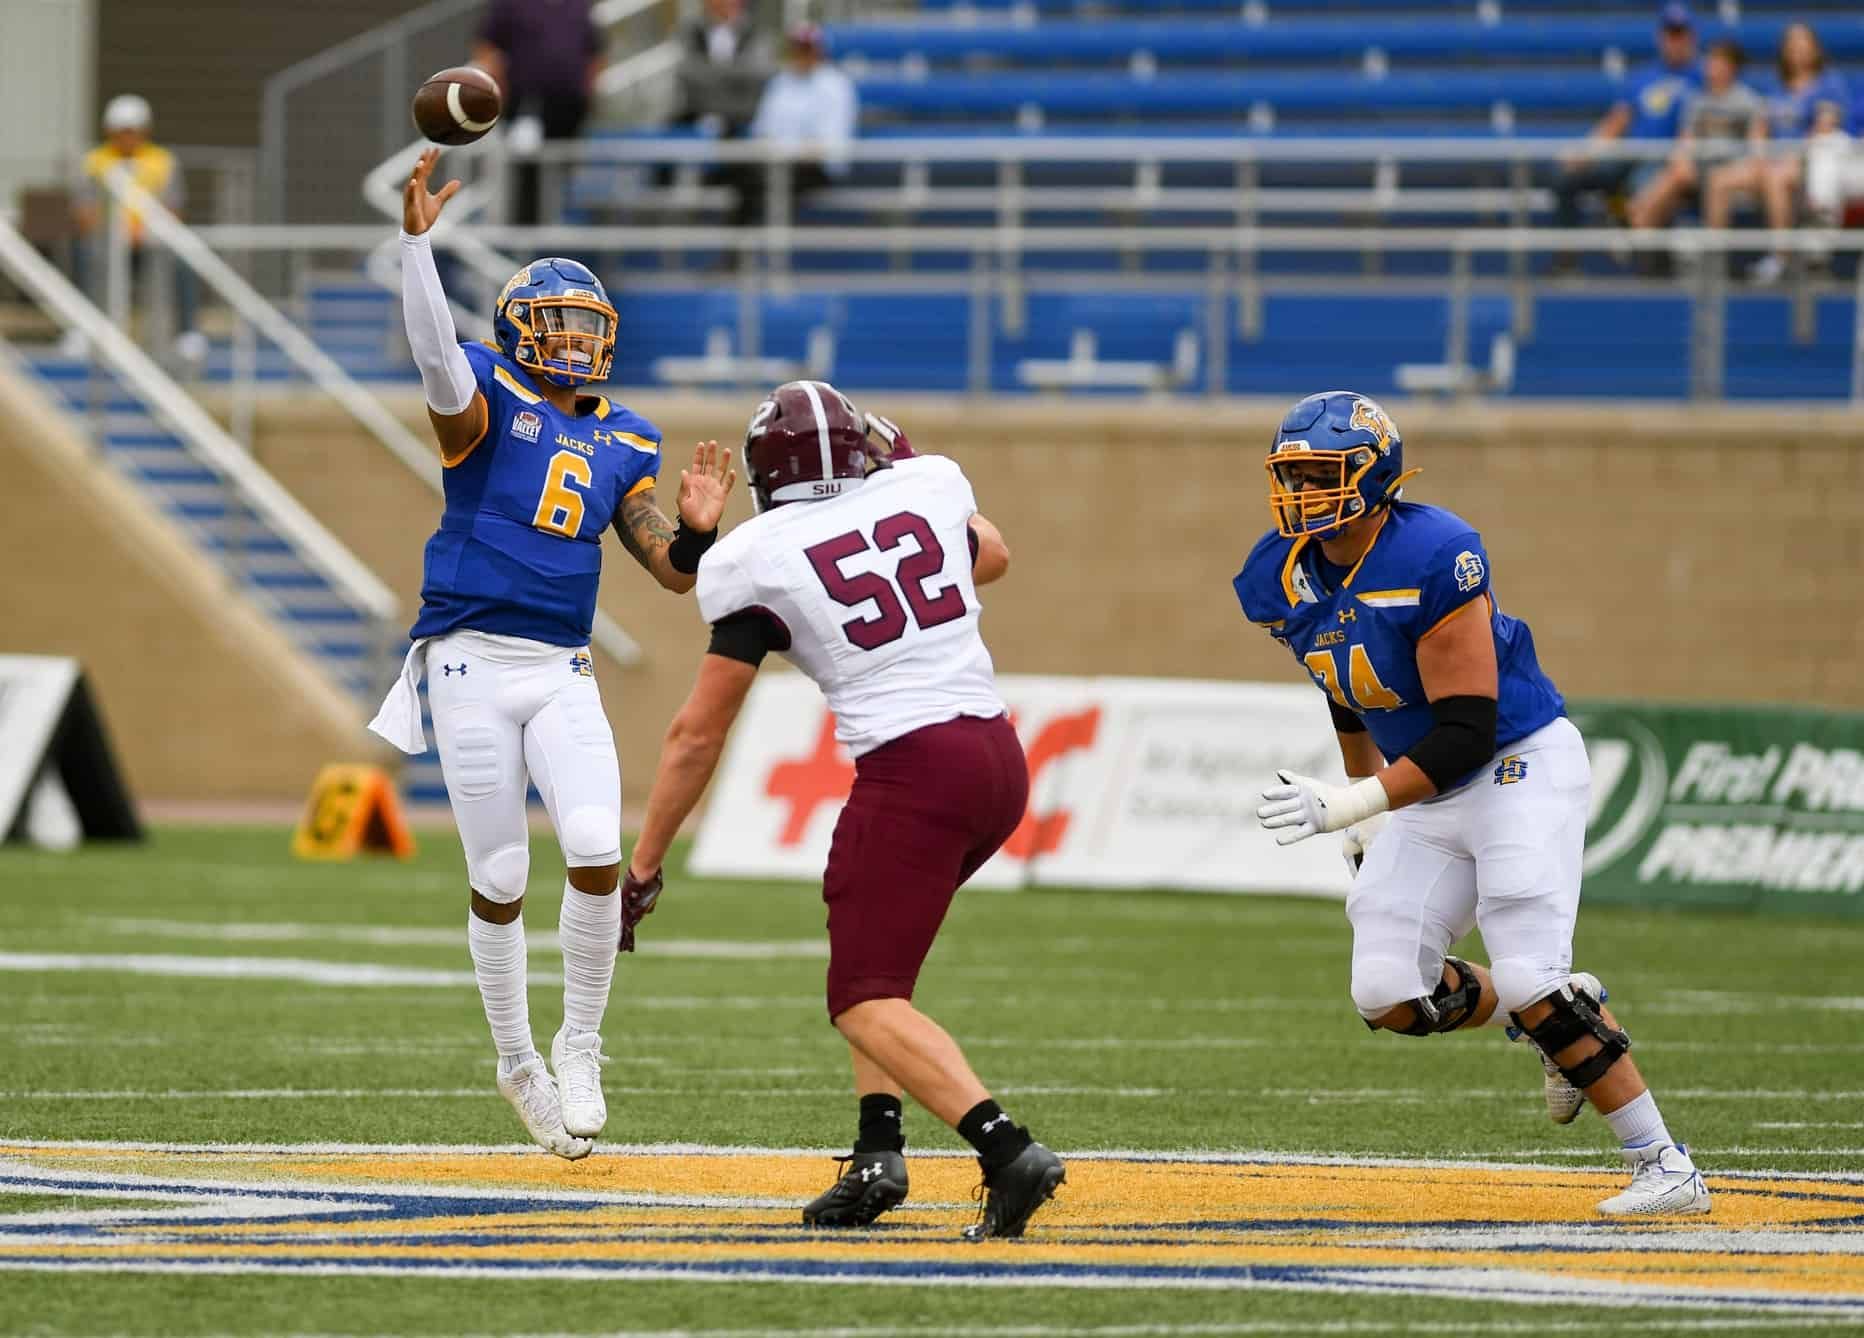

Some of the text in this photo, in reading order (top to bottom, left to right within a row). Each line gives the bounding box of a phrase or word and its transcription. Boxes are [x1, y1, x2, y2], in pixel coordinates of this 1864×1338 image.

[555, 433, 595, 456] JACKS
[532, 449, 592, 539] 6
[813, 483, 842, 496] SIU
[803, 511, 967, 651] 52
[1314, 630, 1346, 648] JACKS
[1303, 643, 1408, 715] 74
[1667, 739, 1783, 803] First
